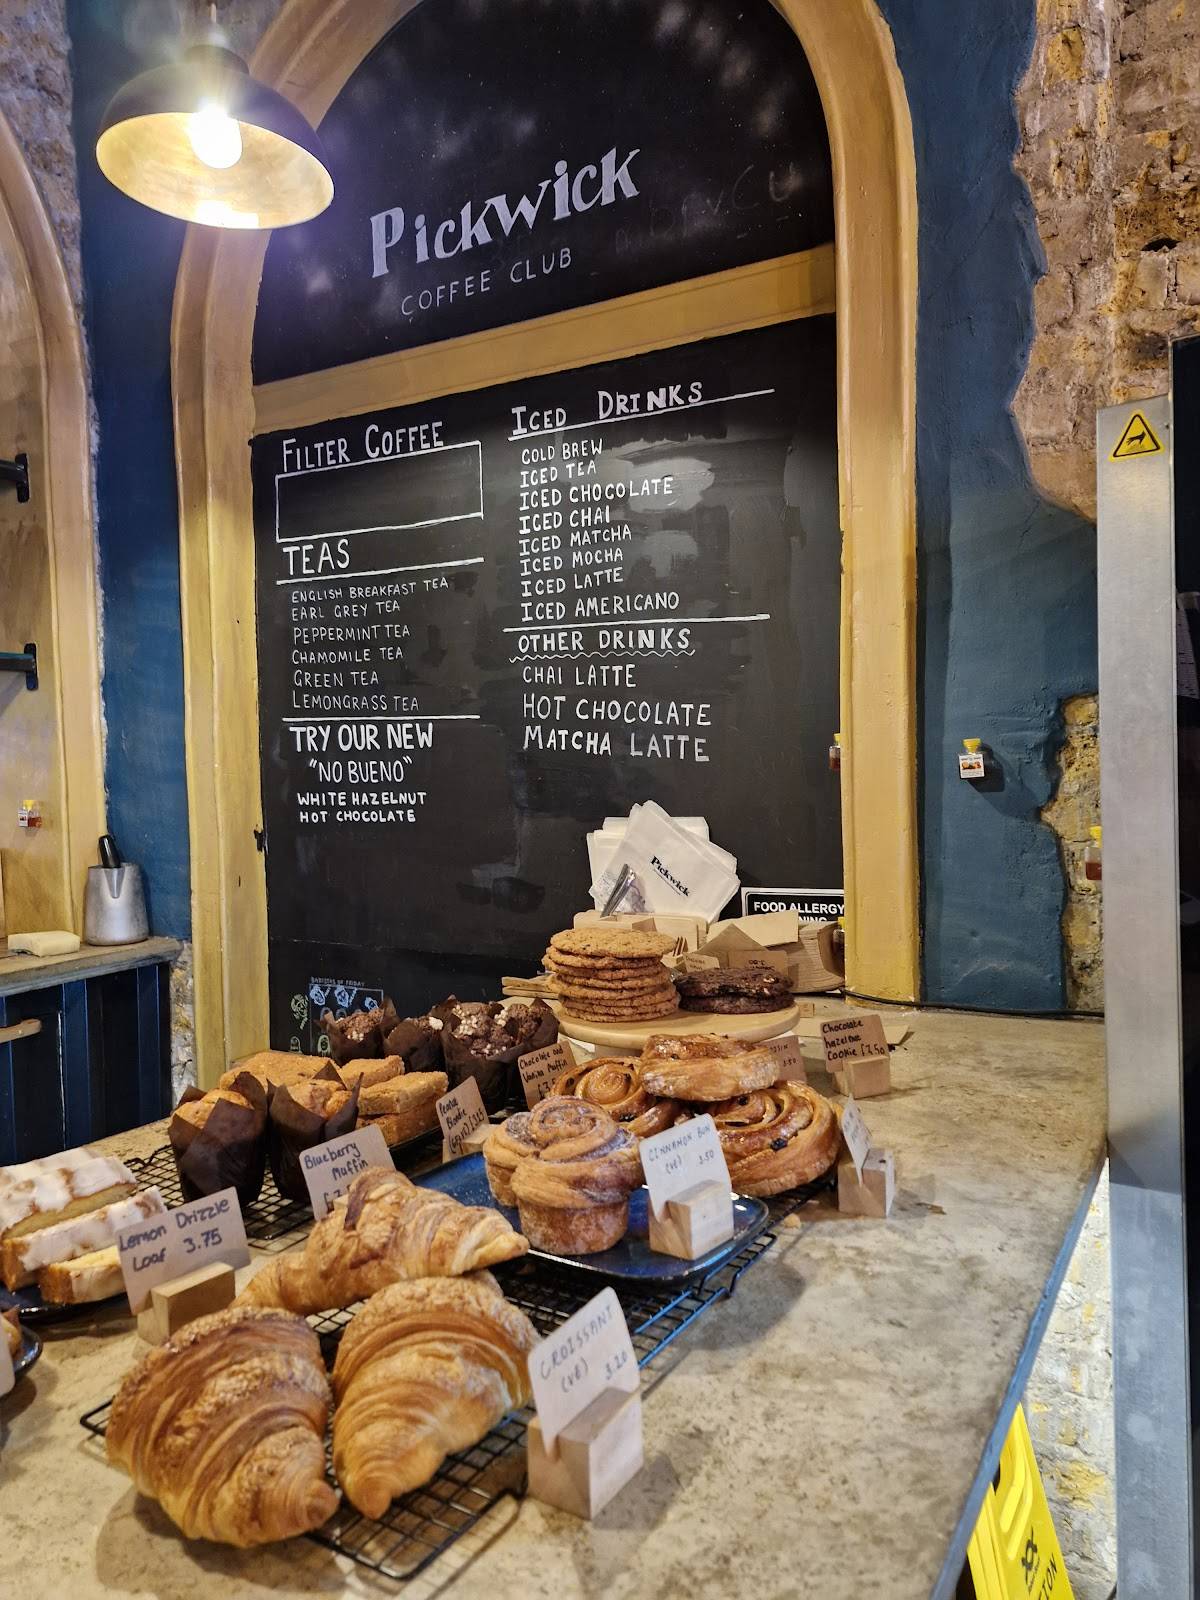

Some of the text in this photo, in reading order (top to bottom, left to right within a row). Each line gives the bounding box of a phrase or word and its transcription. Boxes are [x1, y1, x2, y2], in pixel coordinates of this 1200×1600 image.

[370, 147, 641, 279] Pickwick
[401, 248, 572, 317] COFFEE CLUB
[511, 381, 703, 436] ICED DRINKS
[282, 421, 444, 472] FILTER COFFEE
[521, 438, 603, 465] COLD BREW
[519, 460, 597, 488] ICED TEA
[519, 477, 674, 511] ICED CHOCOLATE
[518, 505, 611, 535] ICED CHAI
[518, 523, 632, 556] ICED MATCHA
[282, 538, 350, 575] TEAS
[519, 547, 624, 577] ICED MOCHA
[292, 576, 449, 604] ENGLISH BREAKFAST TEA
[521, 566, 624, 598] ICED LATTE
[292, 600, 401, 622] EARL GREY TEA
[520, 591, 680, 622] ICED AMERICANO
[293, 624, 411, 645] PEPPERMINT TEA
[518, 627, 691, 653] OTHER DRINKS
[292, 647, 404, 665] CHAMOMILE TEA
[293, 669, 379, 688] GREEN TEA
[522, 663, 637, 688] CHAI LATTE
[292, 690, 420, 712] LEMONGRASS TEA
[523, 692, 712, 727] HOT CHOCOLATE
[289, 722, 433, 752] TRY OUR NEW
[522, 725, 710, 762] MATCHA LATTE
[297, 791, 427, 806] WHITE HAZELNUT
[299, 809, 416, 824] HOT CHOCOLATE
[651, 855, 690, 897] Pickwick
[754, 901, 845, 914] FOOD ALLERGY
[822, 1019, 864, 1034] Chocolate
[827, 1047, 858, 1061] Cookie
[304, 1142, 361, 1169] Blueberry
[648, 1131, 692, 1162] CINNAMON
[331, 1158, 369, 1180] Muffin
[119, 1198, 231, 1252] Lemon Drizzle
[133, 1227, 223, 1272] Loaf 3.75
[541, 1304, 613, 1380] CROISSANT
